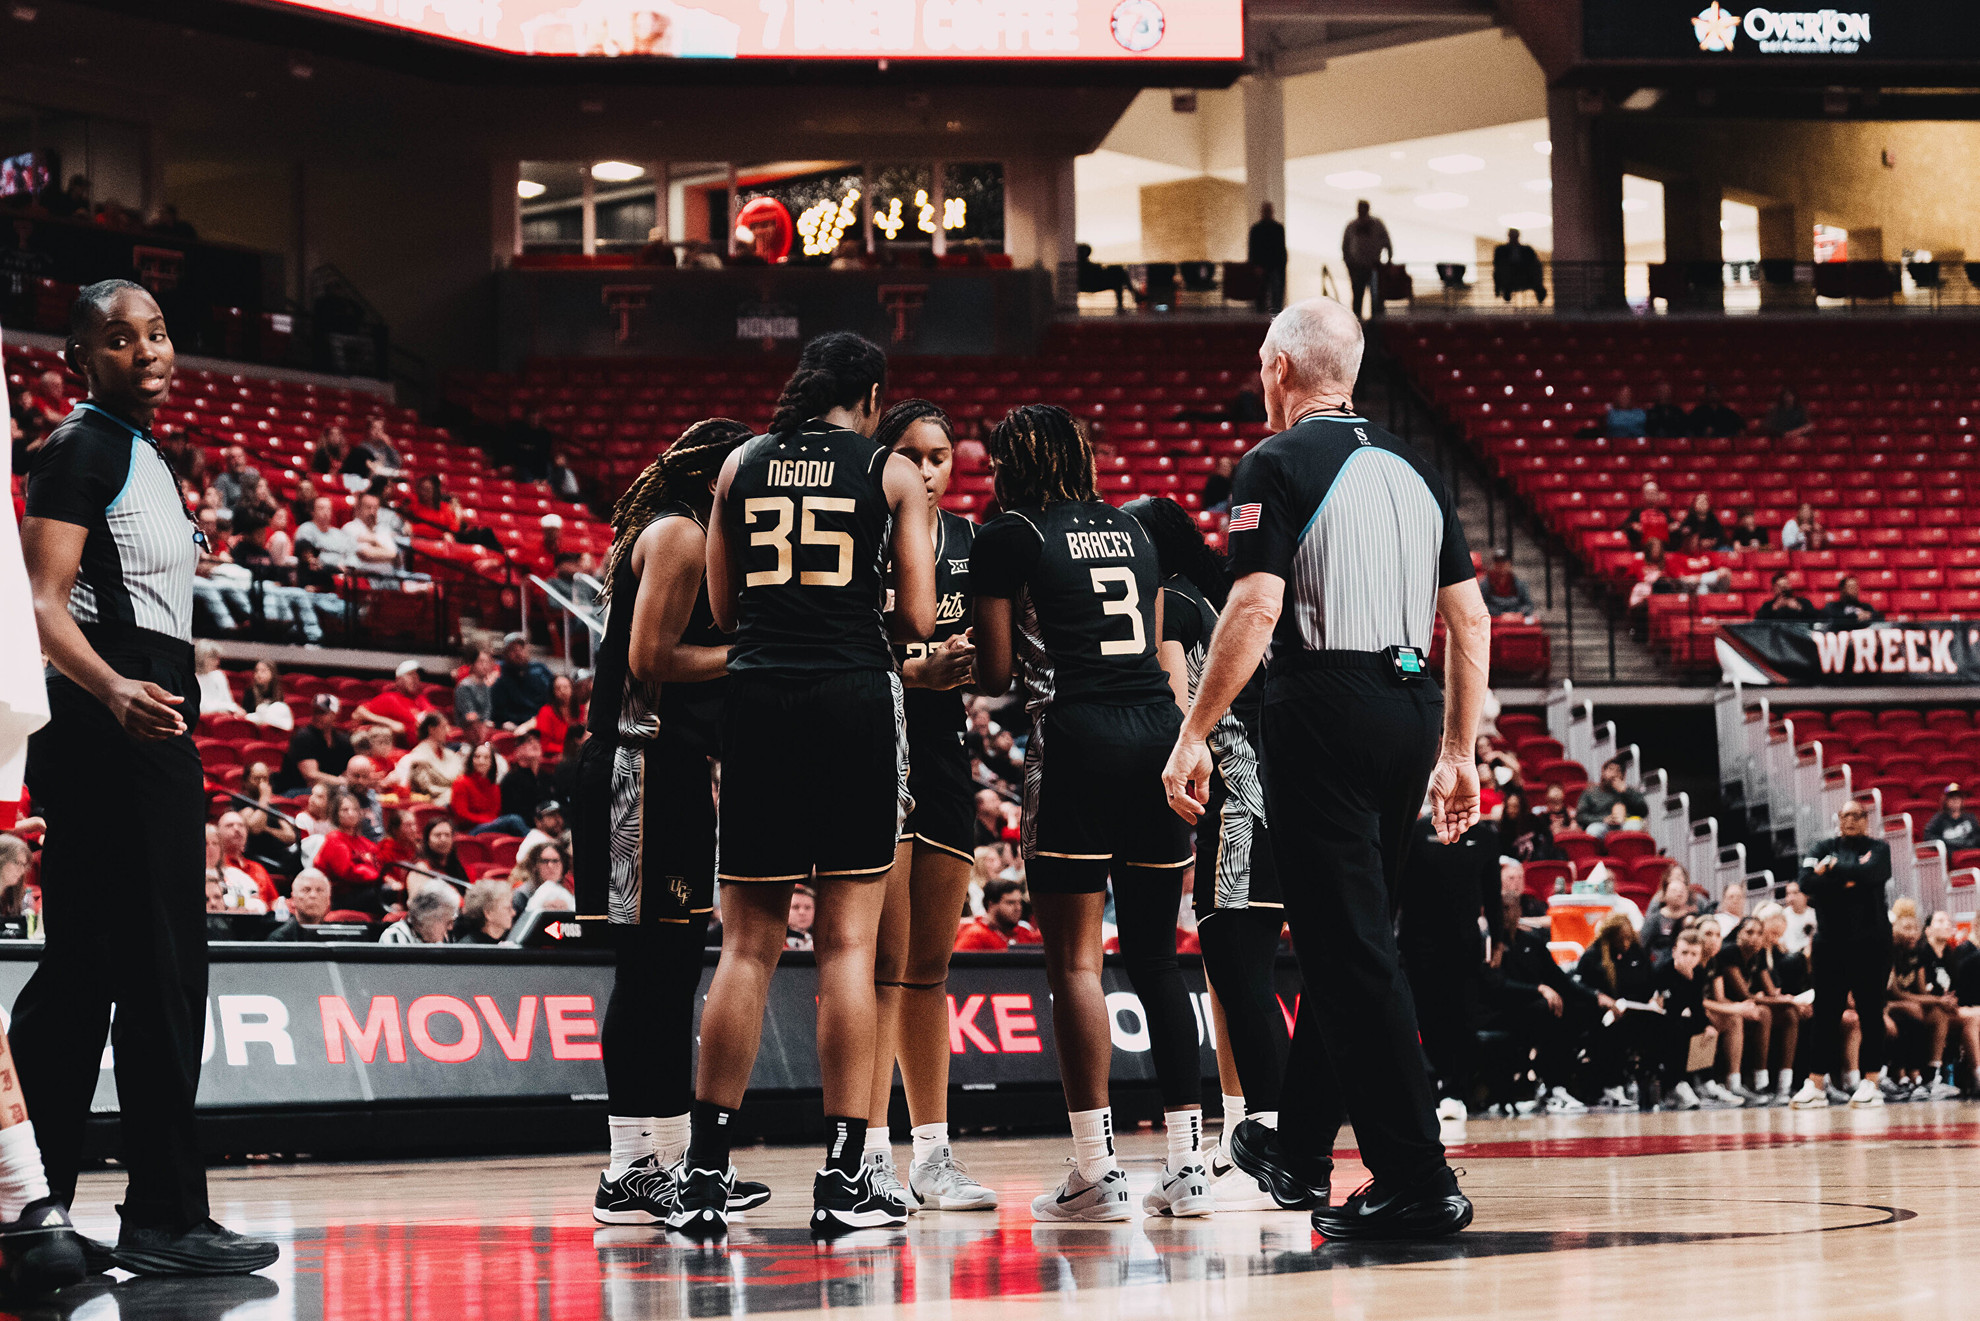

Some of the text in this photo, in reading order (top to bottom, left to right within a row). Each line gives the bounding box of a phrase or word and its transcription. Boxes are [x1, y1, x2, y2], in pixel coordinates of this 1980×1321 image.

[767, 459, 835, 487] NGODU
[744, 496, 856, 588] 35
[1065, 531, 1135, 559] BRACEY
[1089, 566, 1147, 655] 3
[1811, 628, 1958, 674] WRECK
[318, 994, 603, 1064] MOVE
